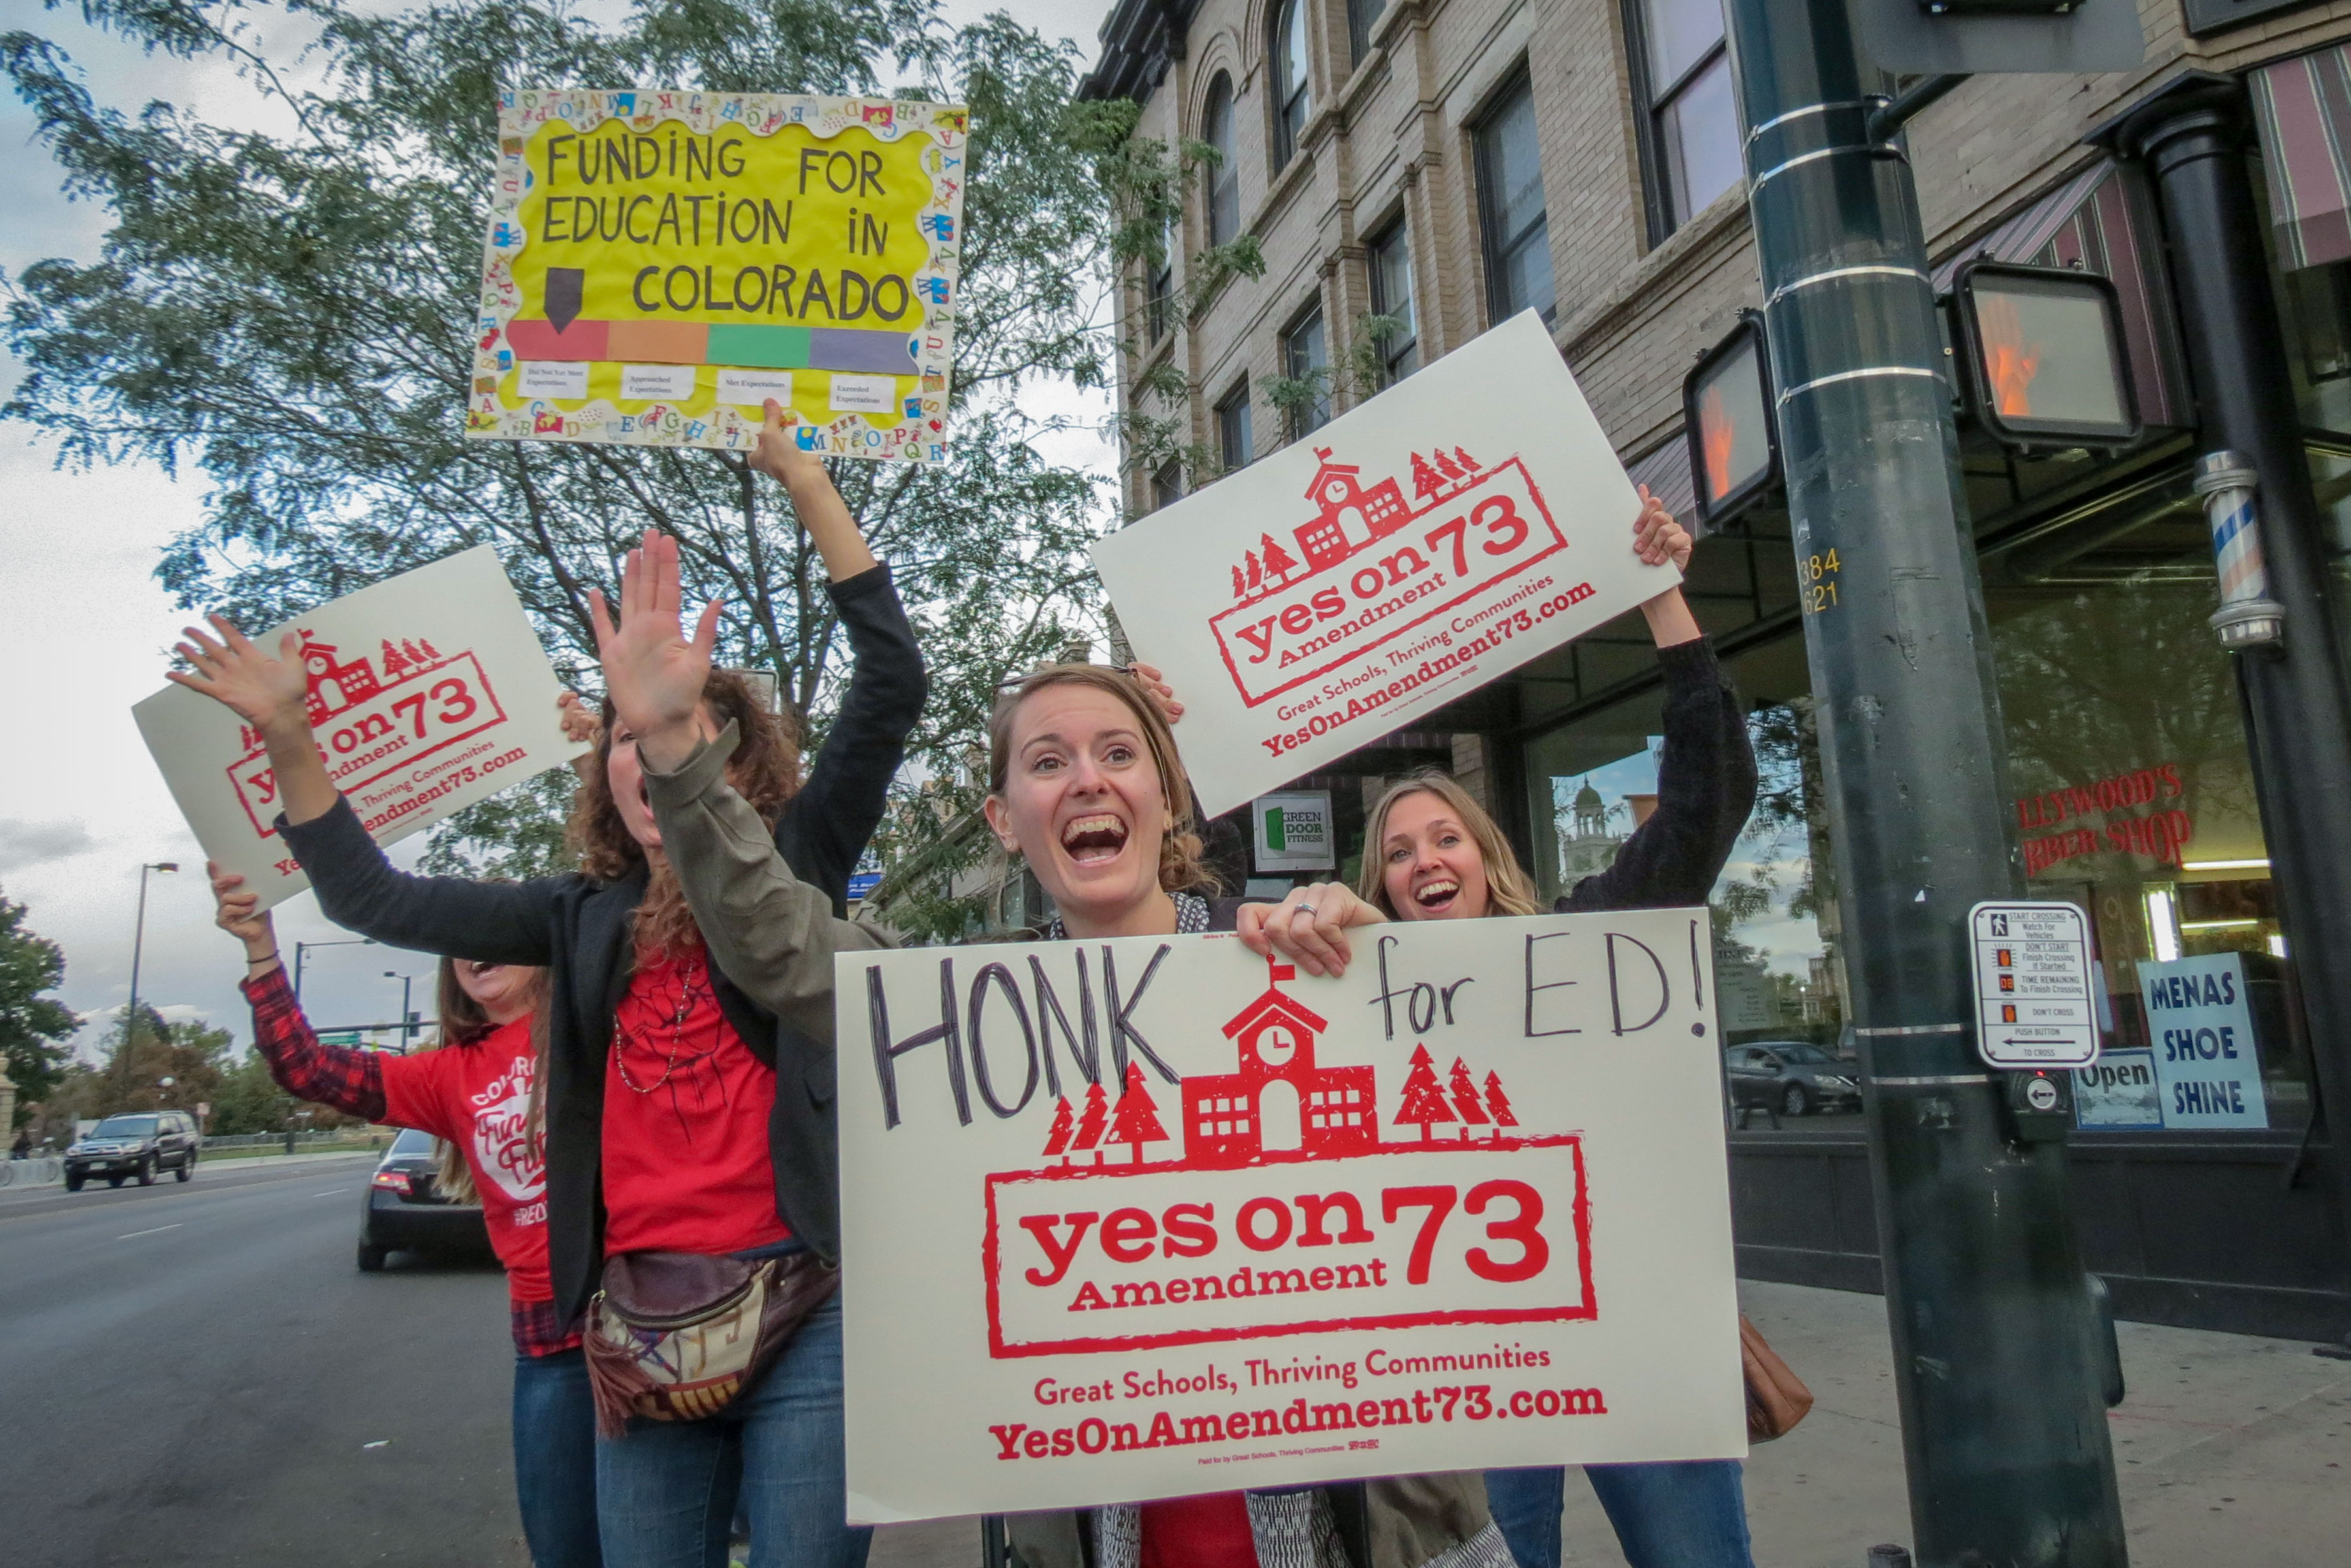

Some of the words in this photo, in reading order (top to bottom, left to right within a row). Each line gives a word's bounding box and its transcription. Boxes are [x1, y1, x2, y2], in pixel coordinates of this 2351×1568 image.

[799, 148, 885, 197] FOR
[633, 265, 908, 321] COLORADO
[836, 395, 880, 404] Expectations
[1236, 583, 1347, 664] yes
[1350, 545, 1430, 599] on
[1424, 494, 1529, 577] 73
[1800, 548, 1840, 585] 384
[1277, 572, 1447, 669] Amendment
[1804, 581, 1837, 615] 621
[1261, 579, 1596, 760] YesOnAmendment73.com
[1277, 692, 1321, 722] Great
[1322, 661, 1388, 702] Schools,
[1386, 630, 1452, 669] Thriving
[1450, 575, 1553, 636] Communities
[332, 713, 395, 754] on
[391, 678, 477, 739] 73
[327, 735, 409, 781] ndment
[361, 780, 414, 808] Thriving
[412, 741, 494, 782] Communities
[1283, 812, 1322, 822] GREEN
[2018, 763, 2182, 830] LLYWOOD'S
[1286, 824, 1322, 833] DOOR
[2023, 829, 2098, 878] RBER
[2105, 810, 2192, 870] SHOP
[2045, 953, 2075, 963] Crossing
[2053, 985, 2083, 995] Crossing
[2150, 972, 2235, 1010] MENAS
[866, 944, 1181, 1131] HONK
[1368, 935, 1475, 1041] for
[1524, 920, 1706, 1038] ED!
[2164, 1026, 2237, 1061] SHOE
[2079, 1064, 2150, 1094] Open
[2173, 1080, 2245, 1114] SHINE
[1019, 1202, 1218, 1287] yes
[1236, 1191, 1374, 1252] on
[1382, 1179, 1549, 1285] 73
[1068, 1258, 1388, 1312] Amendment
[1034, 1377, 1113, 1405] Great
[1121, 1365, 1238, 1398] Schools,
[1245, 1354, 1358, 1389] Thriving
[1365, 1345, 1551, 1376] Communities
[989, 1384, 1608, 1462] YesOnAmendment73.com
[1279, 1448, 1303, 1457] Thriving
[1305, 1445, 1345, 1454] Communities
